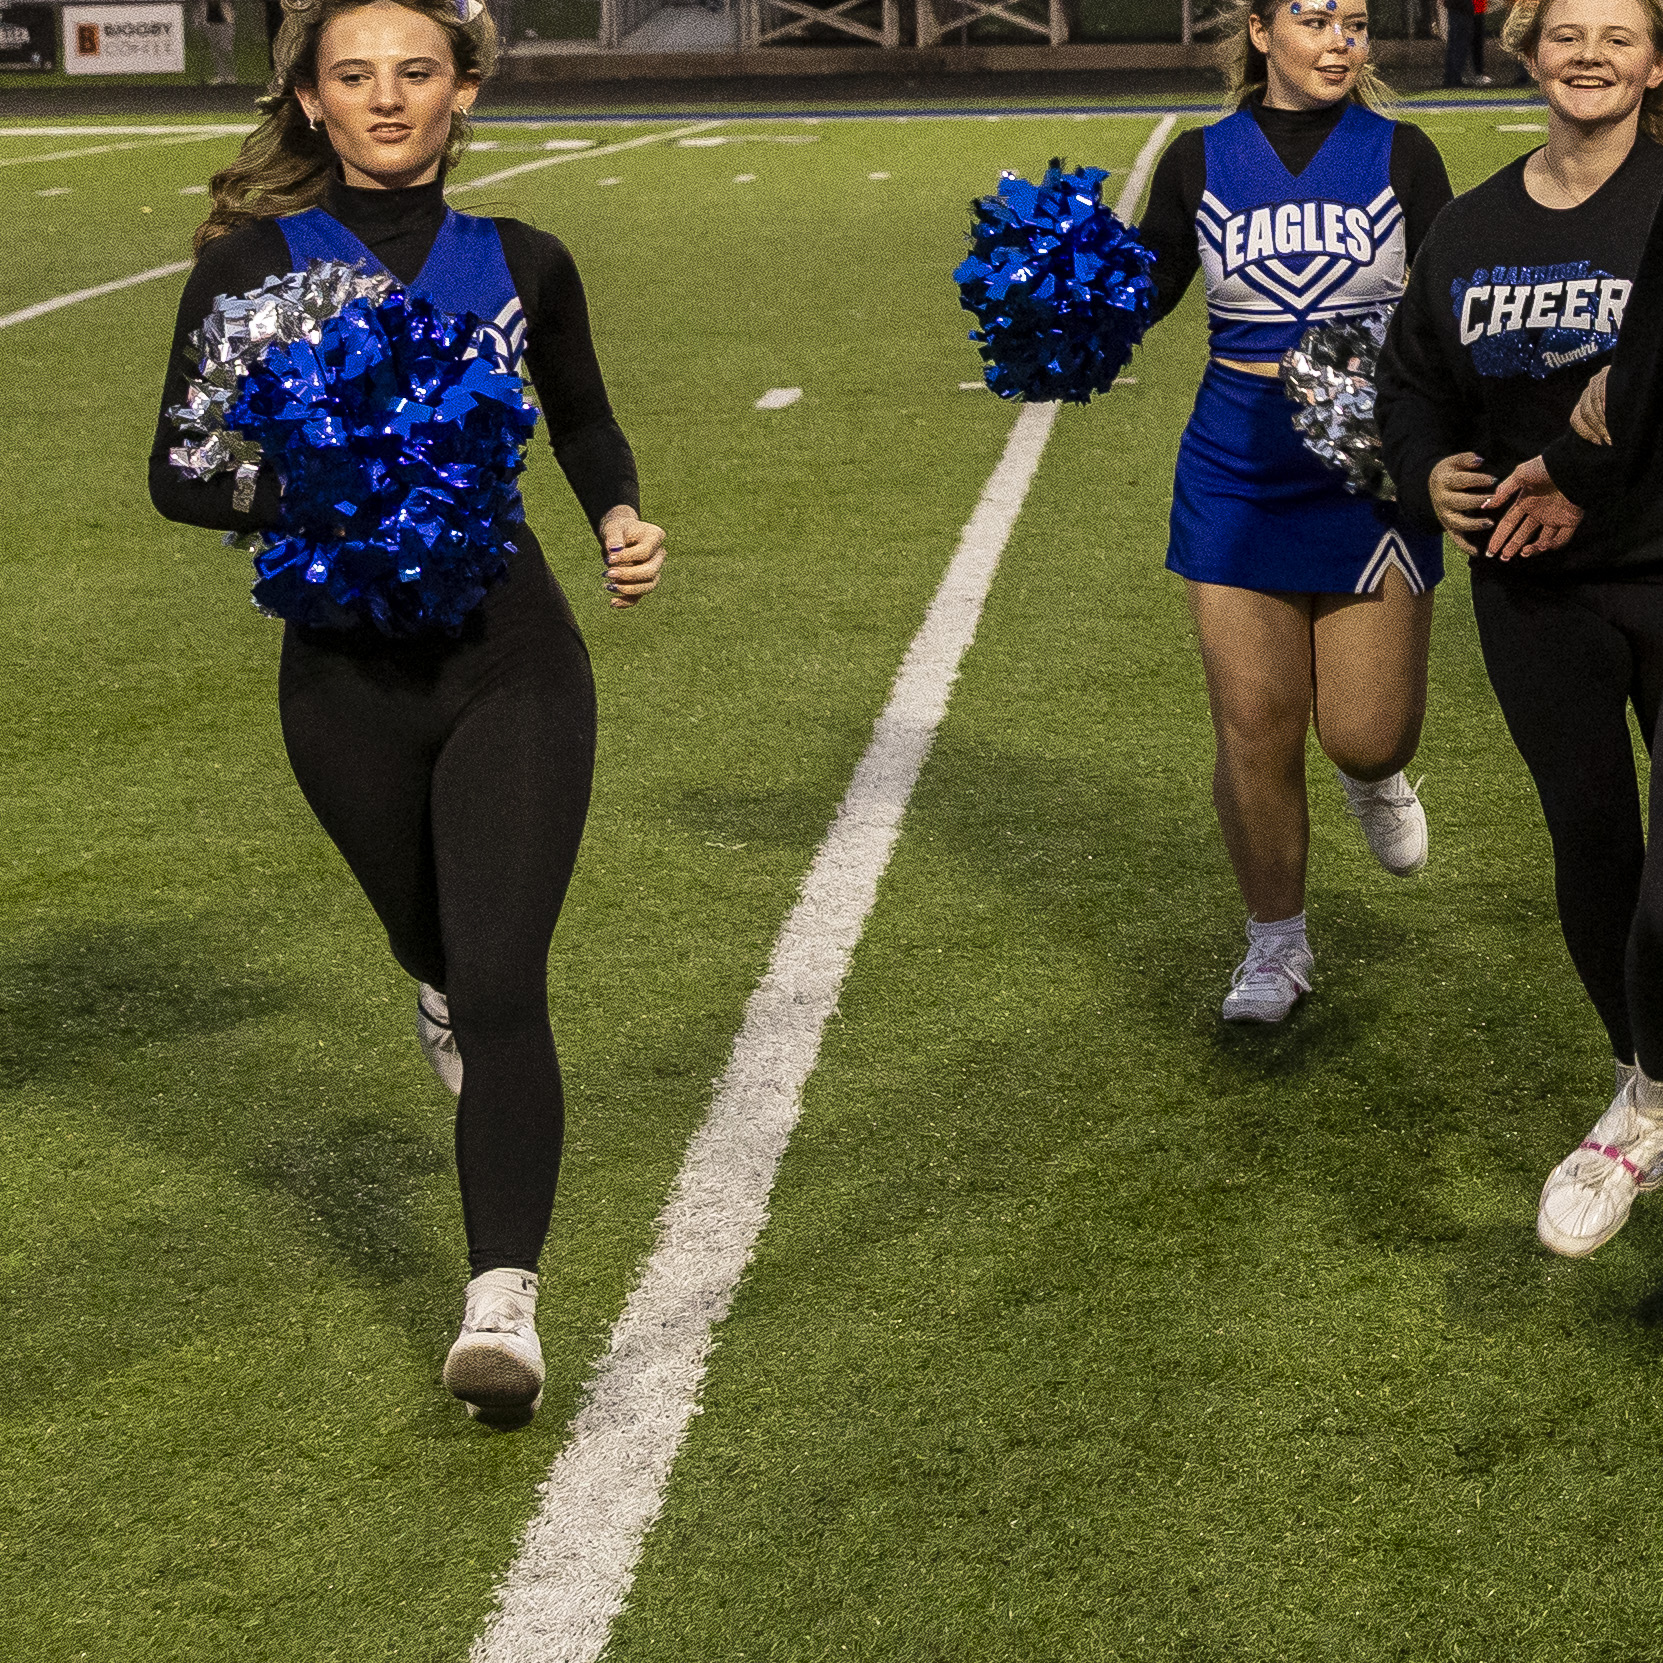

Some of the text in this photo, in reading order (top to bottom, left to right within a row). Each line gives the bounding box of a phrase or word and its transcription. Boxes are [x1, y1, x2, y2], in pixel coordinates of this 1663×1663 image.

[1225, 202, 1373, 271] EAGLES
[1460, 278, 1634, 346] CHEER
[1541, 336, 1599, 368] Alumni
